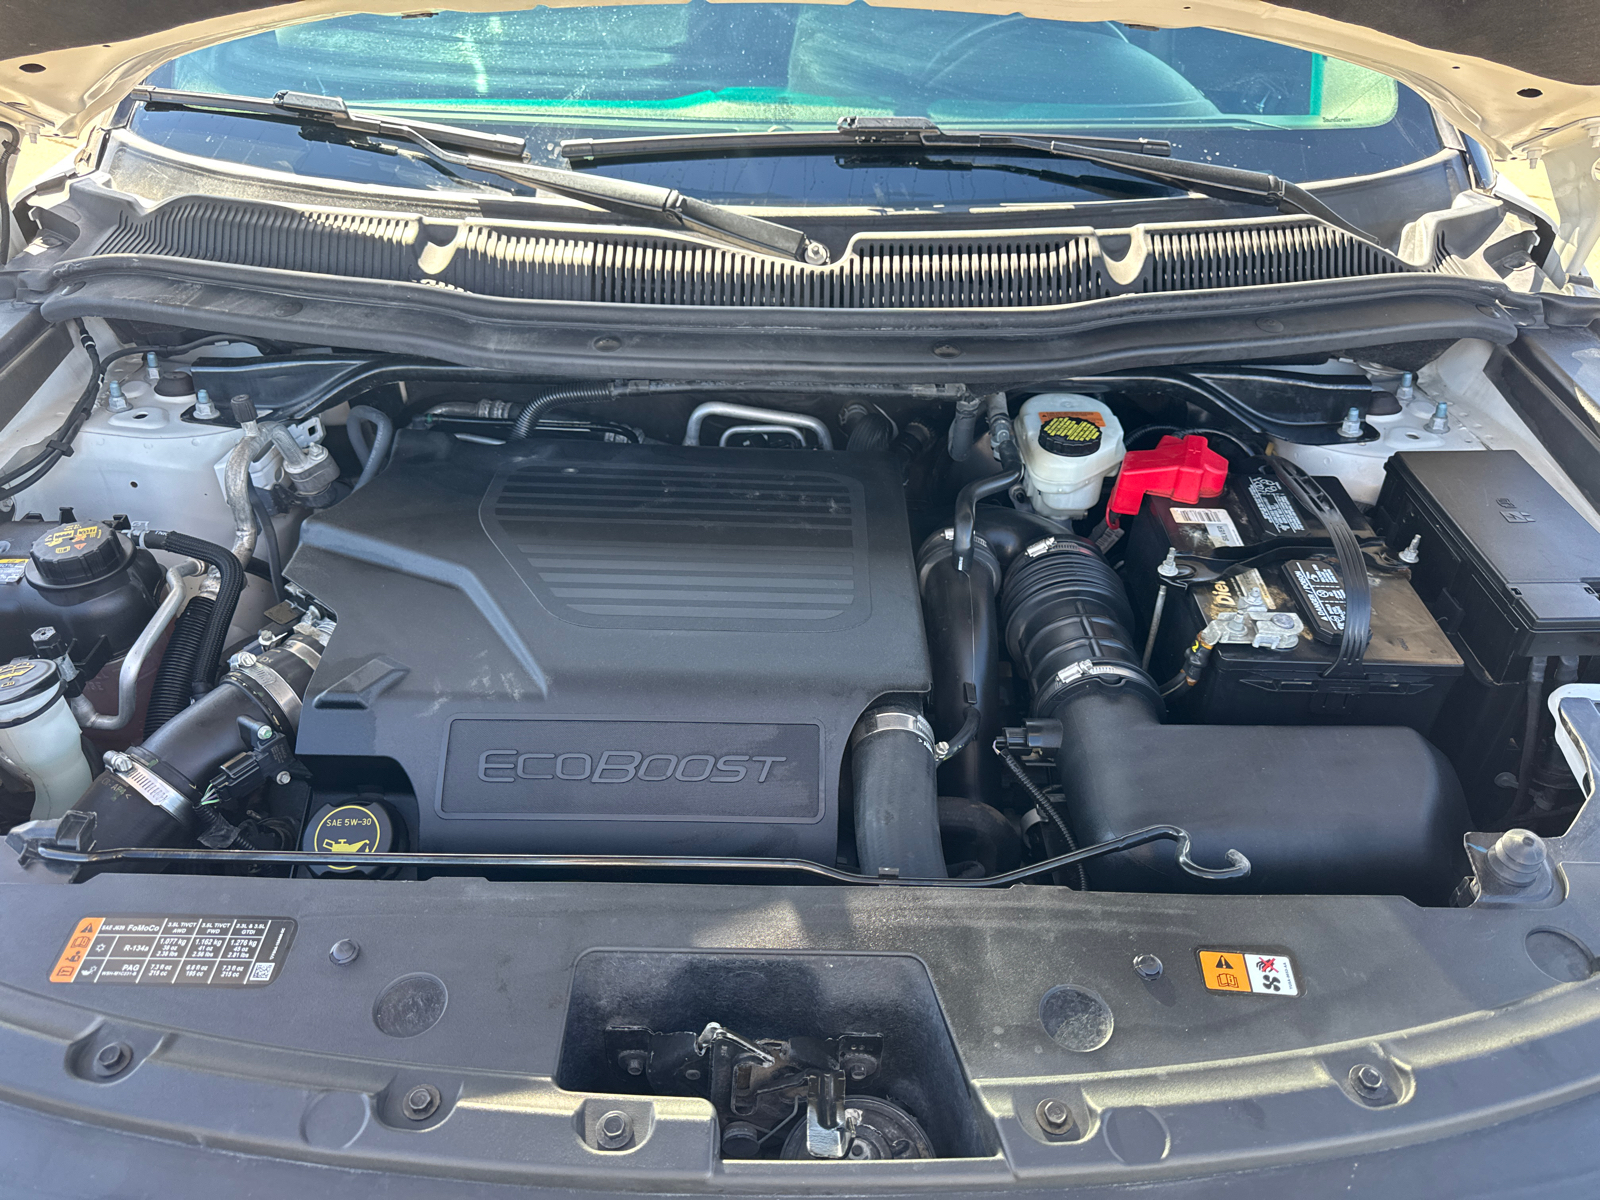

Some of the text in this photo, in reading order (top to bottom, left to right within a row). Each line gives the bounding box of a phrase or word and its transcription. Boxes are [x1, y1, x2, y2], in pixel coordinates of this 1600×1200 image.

[326, 817, 372, 827] SAE 5W-30
[127, 924, 160, 932] FoMoCo
[160, 937, 187, 946] 1.077 kg
[195, 938, 222, 947] 1.162 kg
[248, 939, 258, 947] kg
[123, 944, 150, 952] R-134a
[121, 963, 140, 971] PAG
